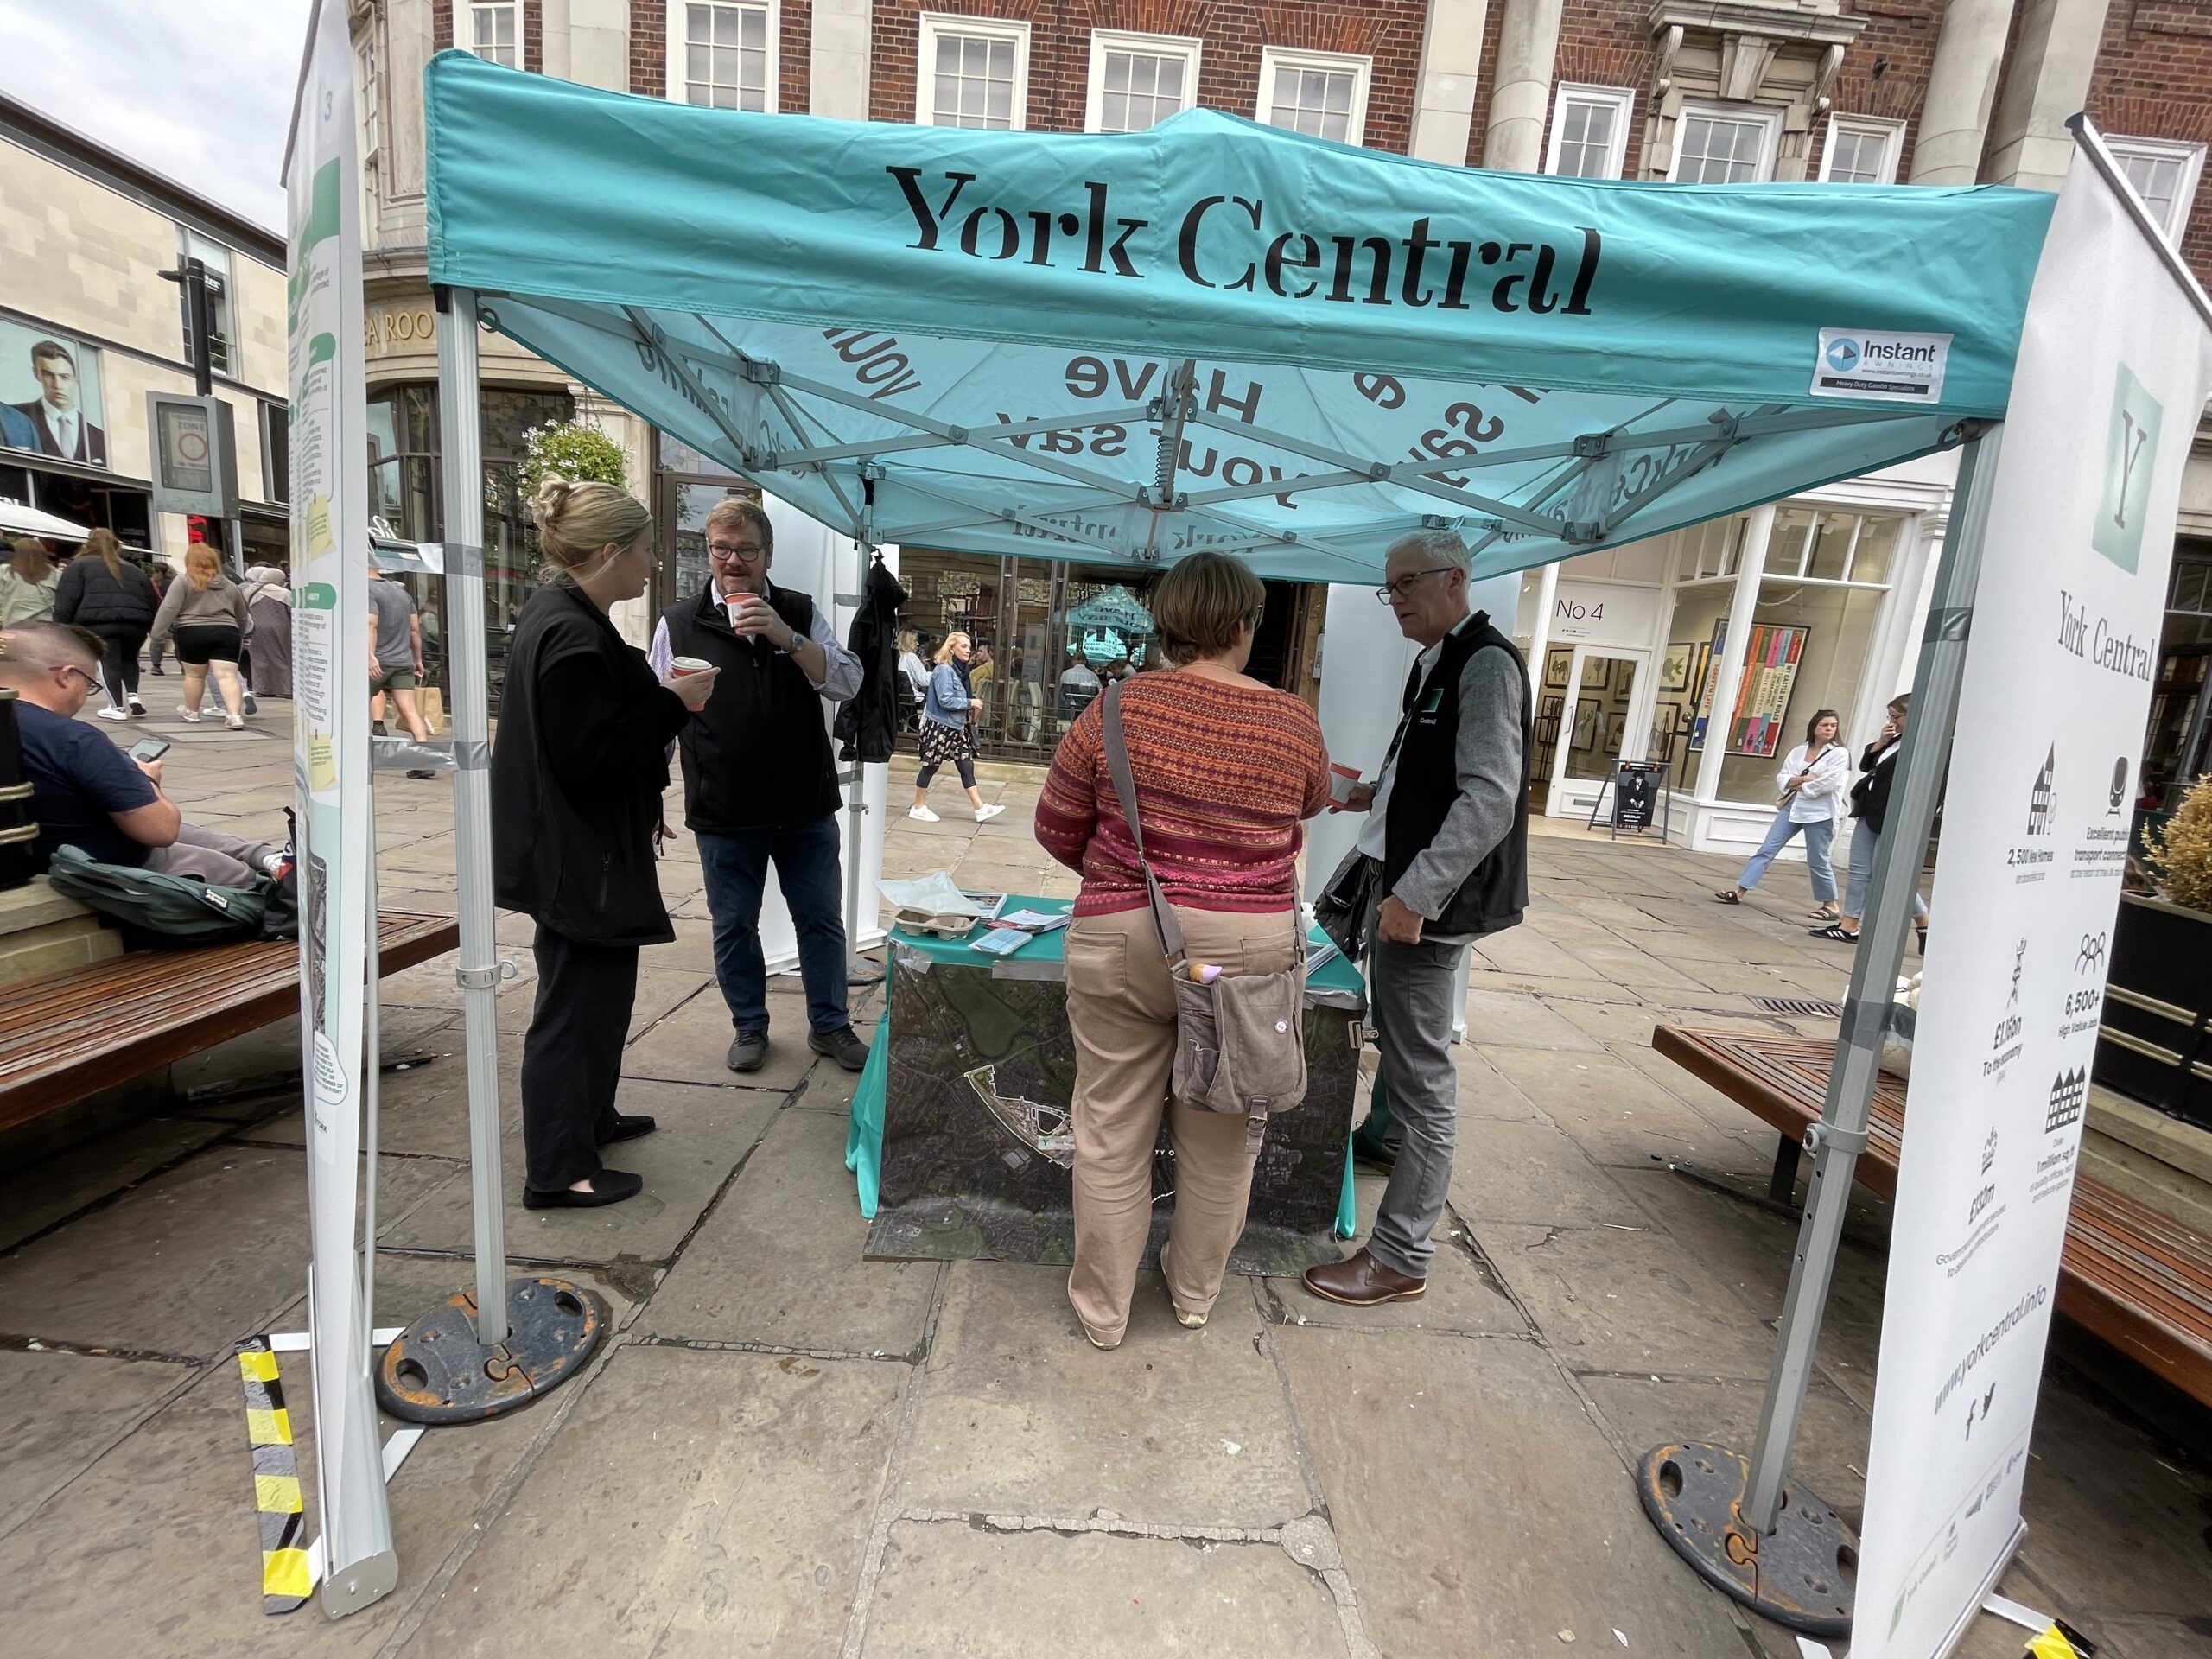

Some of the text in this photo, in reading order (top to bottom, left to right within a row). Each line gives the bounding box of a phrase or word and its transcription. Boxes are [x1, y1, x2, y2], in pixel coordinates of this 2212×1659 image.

[886, 166, 1601, 316] York Central
[384, 310, 434, 340] ROO
[1863, 340, 1936, 362] Instant
[178, 421, 206, 430] ZONE
[2114, 410, 2148, 529] Y
[1556, 599, 1604, 621] No 4
[2058, 589, 2157, 683] York Central
[1784, 665, 1793, 674] MY
[1779, 674, 1790, 695] CASTLE
[1704, 694, 1713, 709] LATE
[1776, 695, 1785, 703] MY
[1772, 704, 1783, 721] RULES
[2065, 988, 2101, 1019] 6,500+
[1983, 1060, 1993, 1077] To
[1934, 1284, 2047, 1415] www.yorkcentral.info
